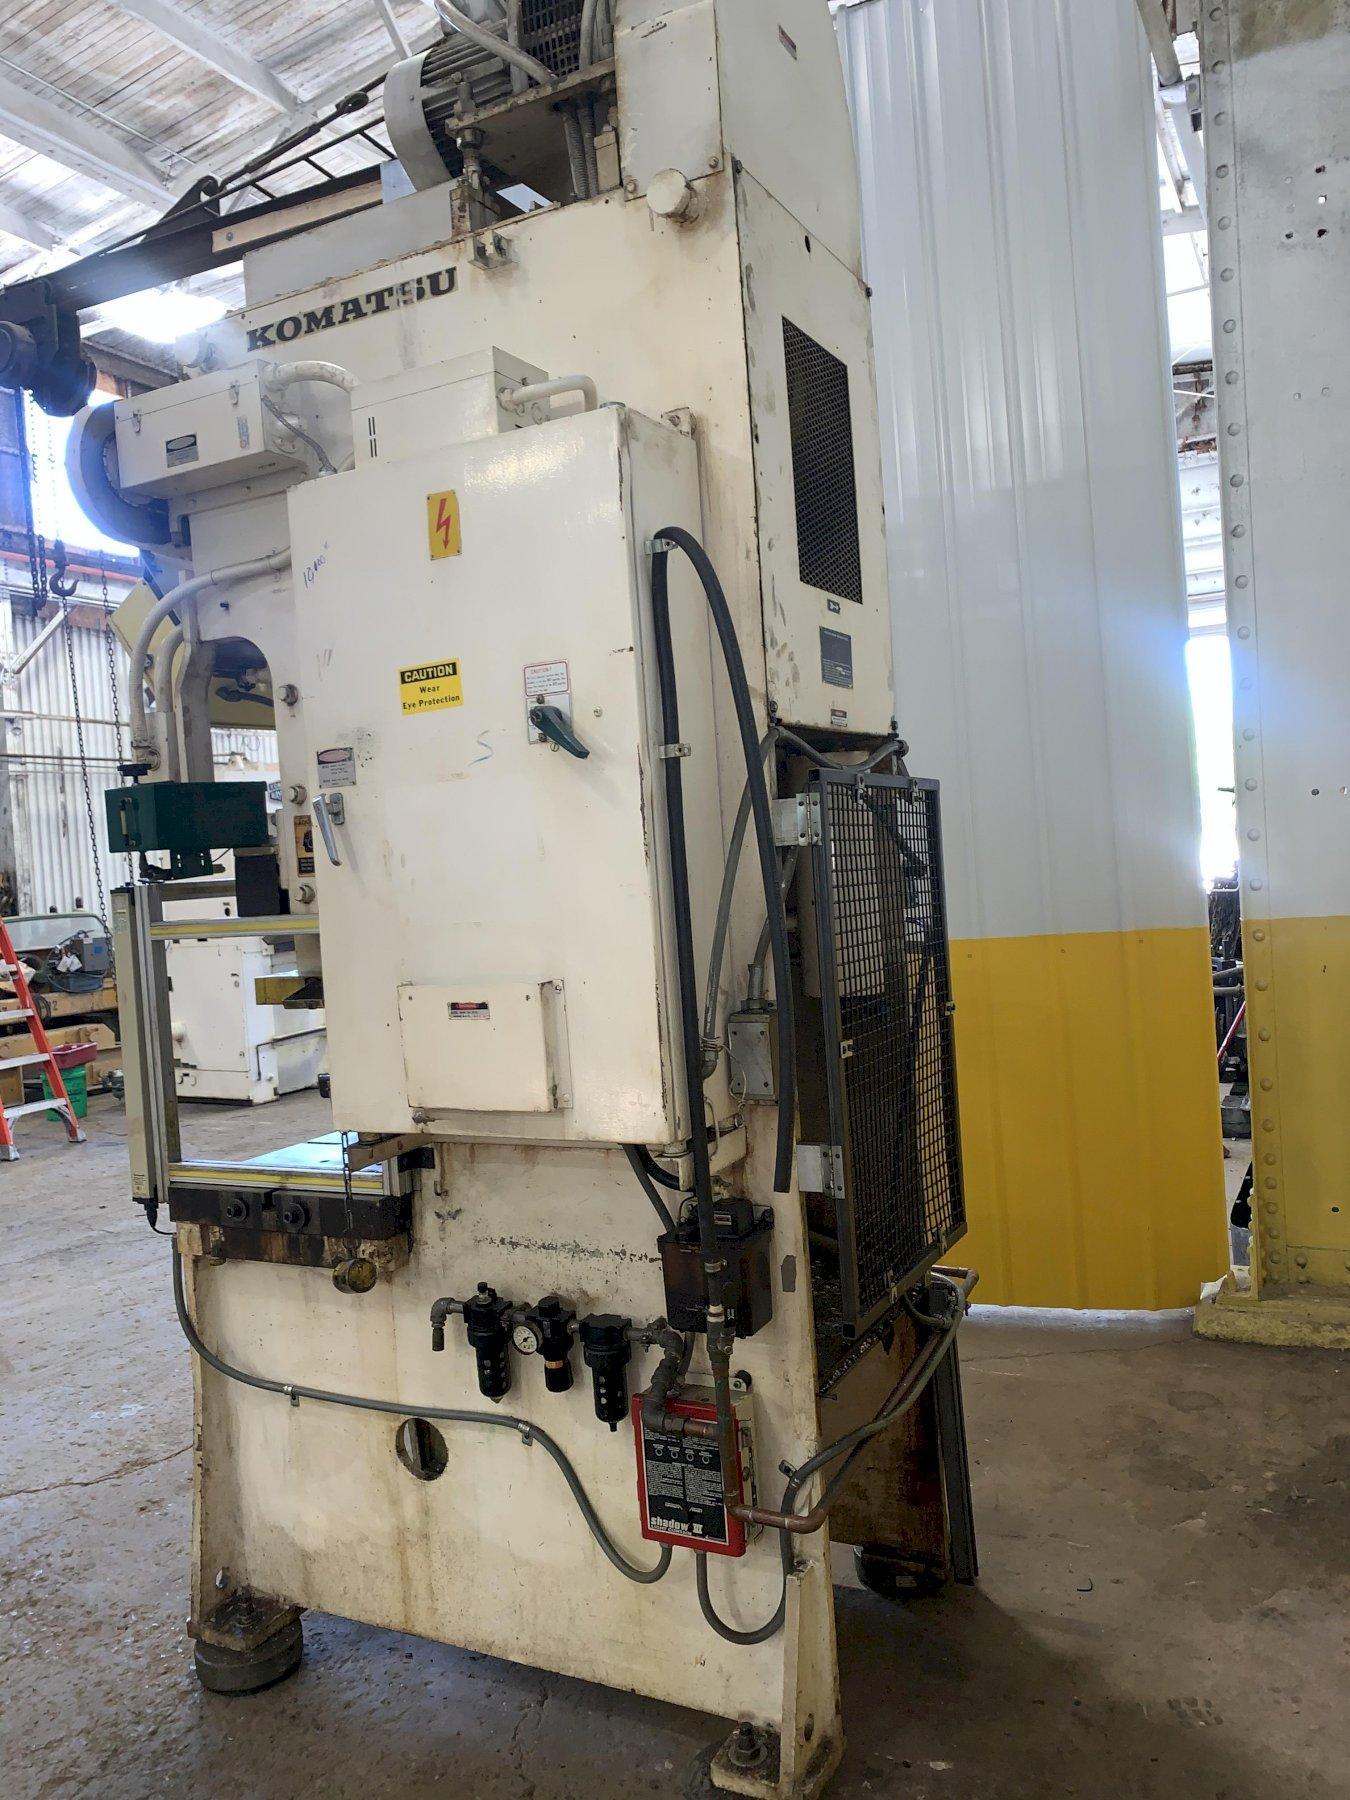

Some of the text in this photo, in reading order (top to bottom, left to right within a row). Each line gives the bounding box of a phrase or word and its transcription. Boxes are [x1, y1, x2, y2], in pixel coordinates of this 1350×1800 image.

[246, 266, 457, 352] KOMATSU
[404, 664, 454, 682] CAUTION
[419, 685, 440, 694] Wear
[402, 695, 460, 710] Eye Protection
[650, 1515, 691, 1531] shadow
